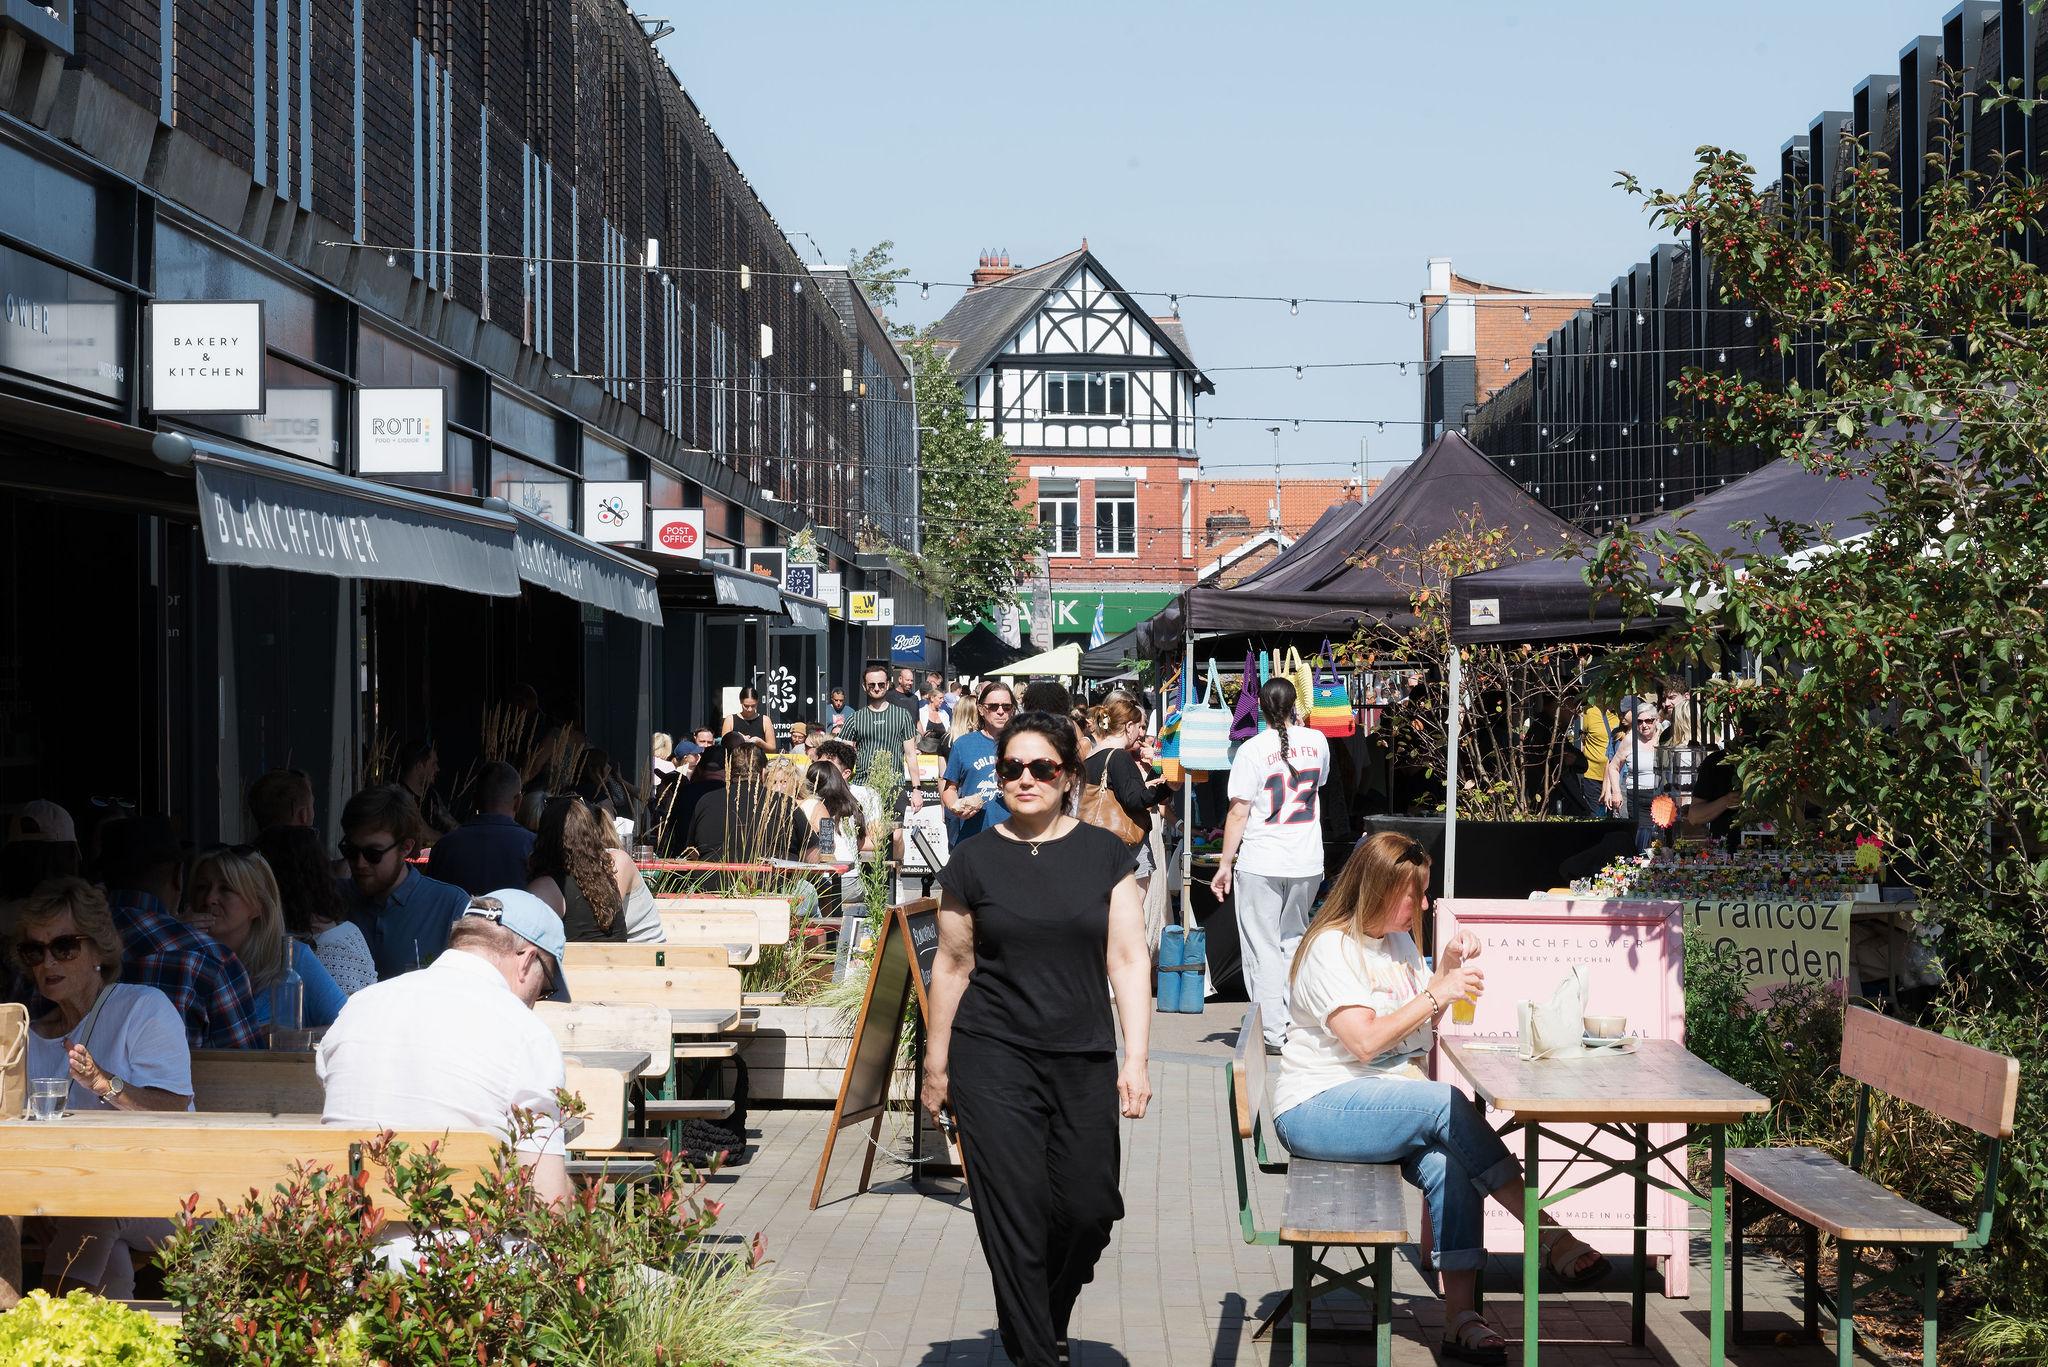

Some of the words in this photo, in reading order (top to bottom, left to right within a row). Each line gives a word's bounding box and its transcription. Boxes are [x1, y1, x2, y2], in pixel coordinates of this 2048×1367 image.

[173, 337, 239, 347] BAKERY
[202, 352, 210, 362] &
[169, 367, 245, 377] KITCHEN
[214, 492, 379, 563] BLANCHFLOWER
[666, 526, 690, 535] POST
[662, 535, 694, 543] OFFICE
[891, 634, 922, 651] Boots
[1267, 746, 1297, 766] CHOEN
[1301, 746, 1319, 759] FEW
[1694, 900, 1839, 931] Francoz
[1487, 937, 1645, 949] LANCHFLOWER
[1714, 936, 1842, 979] Garden
[1566, 1211, 1594, 1219] MADE
